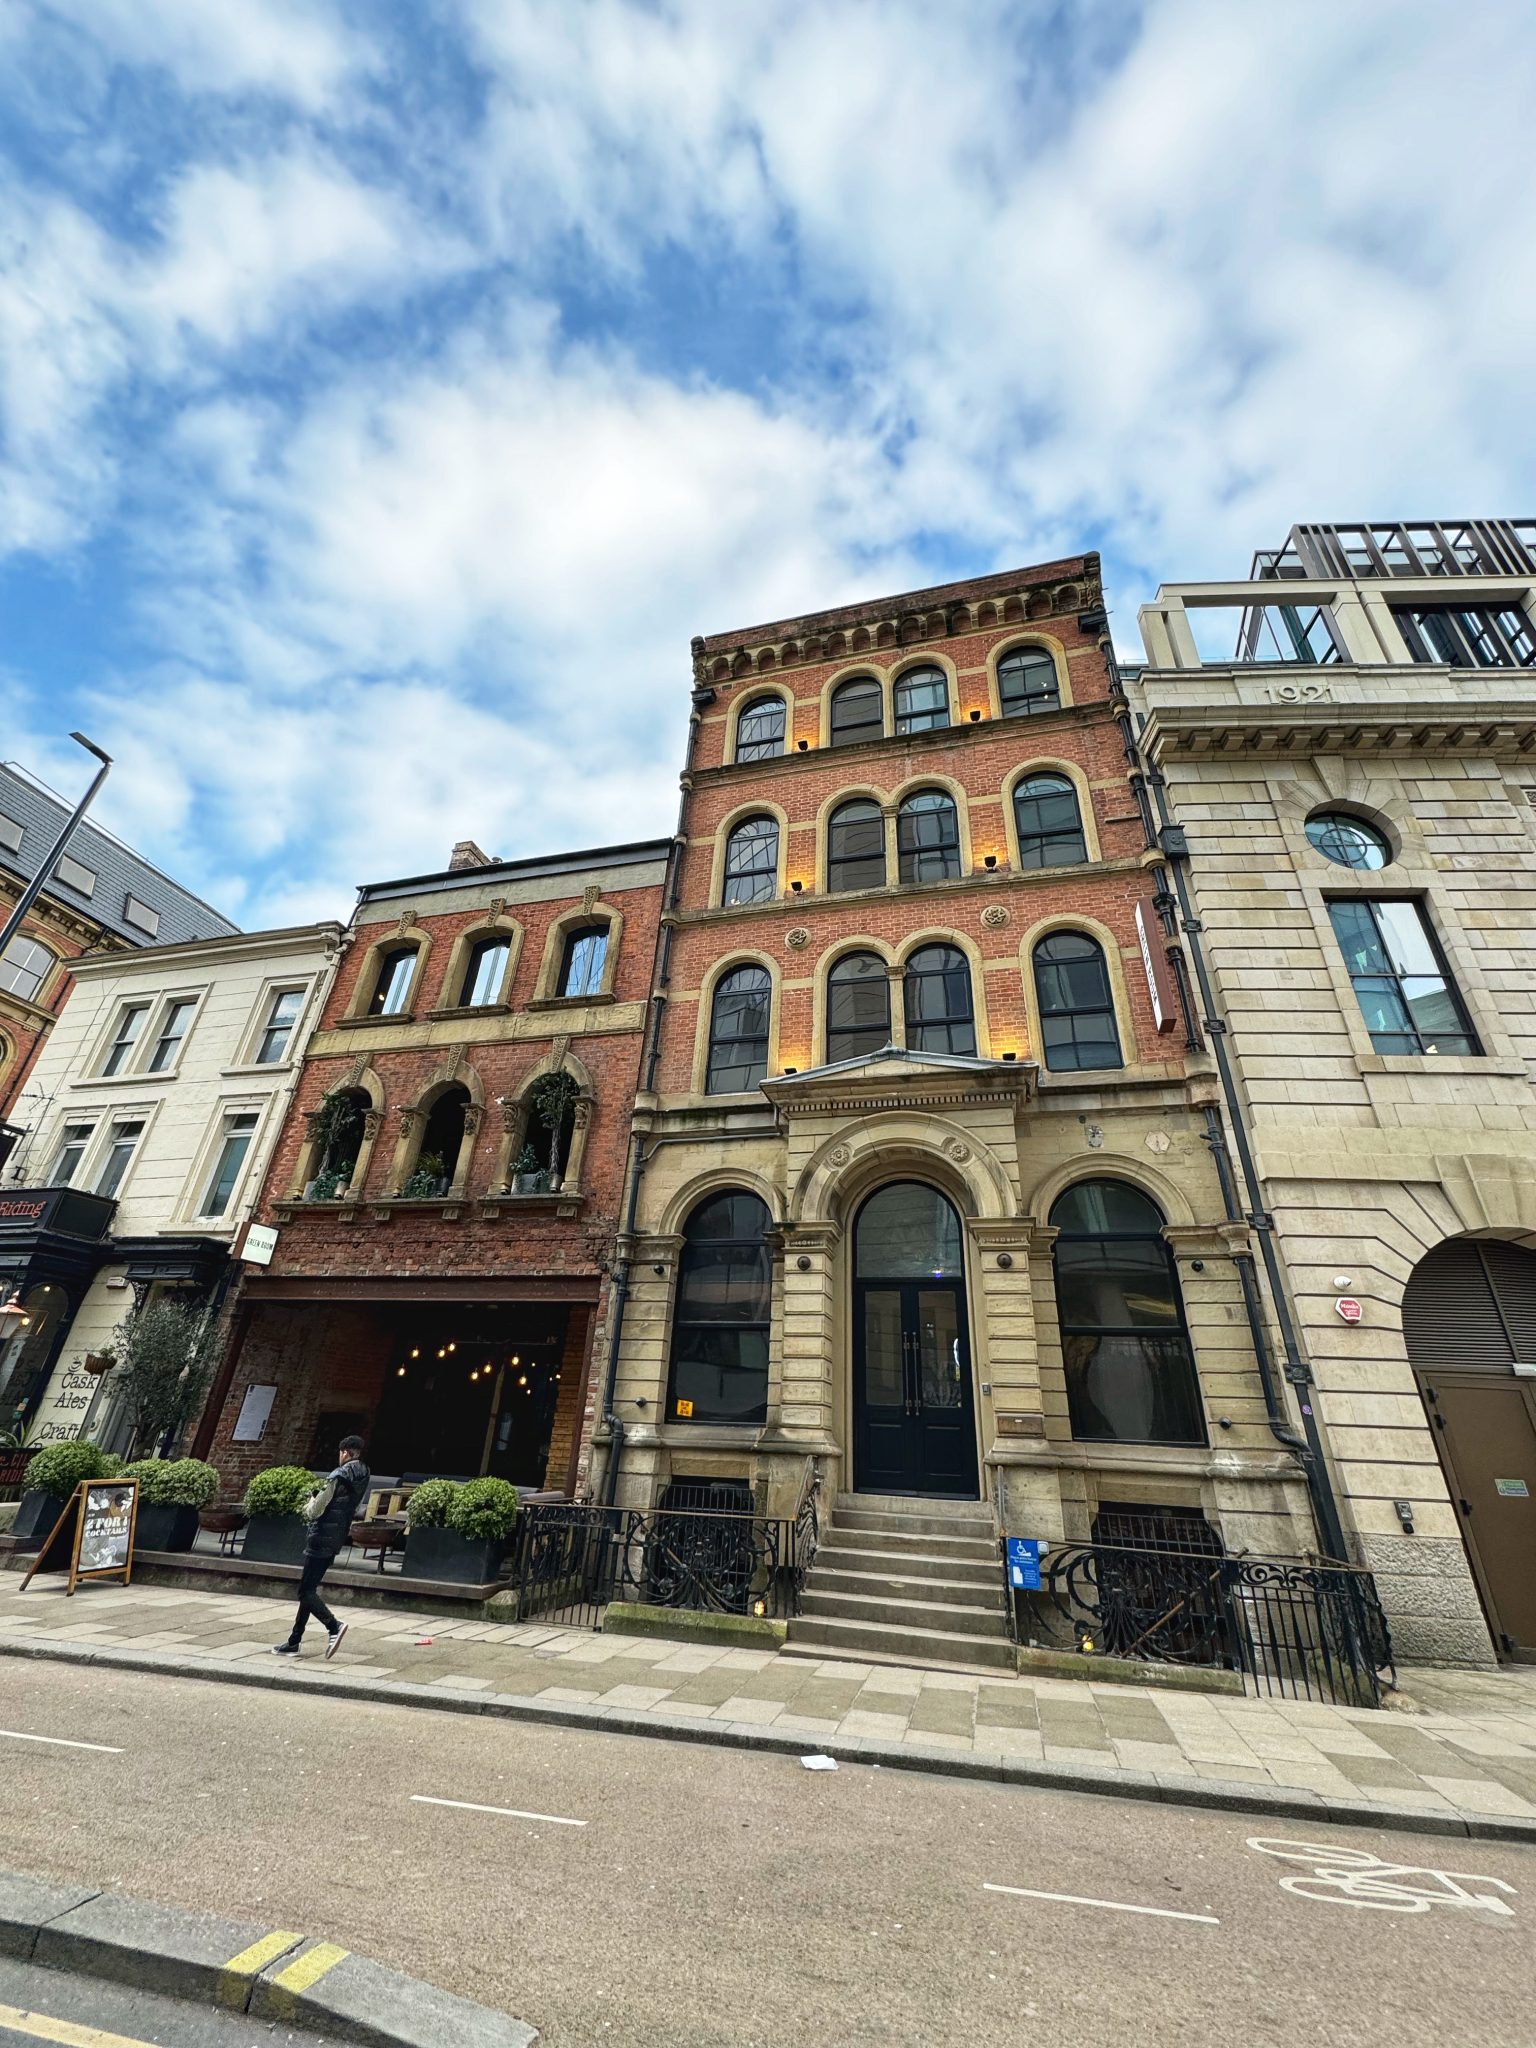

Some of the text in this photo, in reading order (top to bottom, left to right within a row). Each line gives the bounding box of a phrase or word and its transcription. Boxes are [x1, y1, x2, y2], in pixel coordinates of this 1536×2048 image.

[1264, 685, 1341, 704] 1921
[0, 1200, 47, 1219] Riding
[247, 1237, 273, 1250] GREEN ROOM
[61, 1372, 98, 1389] Cask
[53, 1392, 88, 1410] Ales
[40, 1422, 80, 1441] Craft
[86, 1519, 95, 1530] 2
[95, 1516, 121, 1529] FOR
[85, 1527, 127, 1538] COCKTAILS
